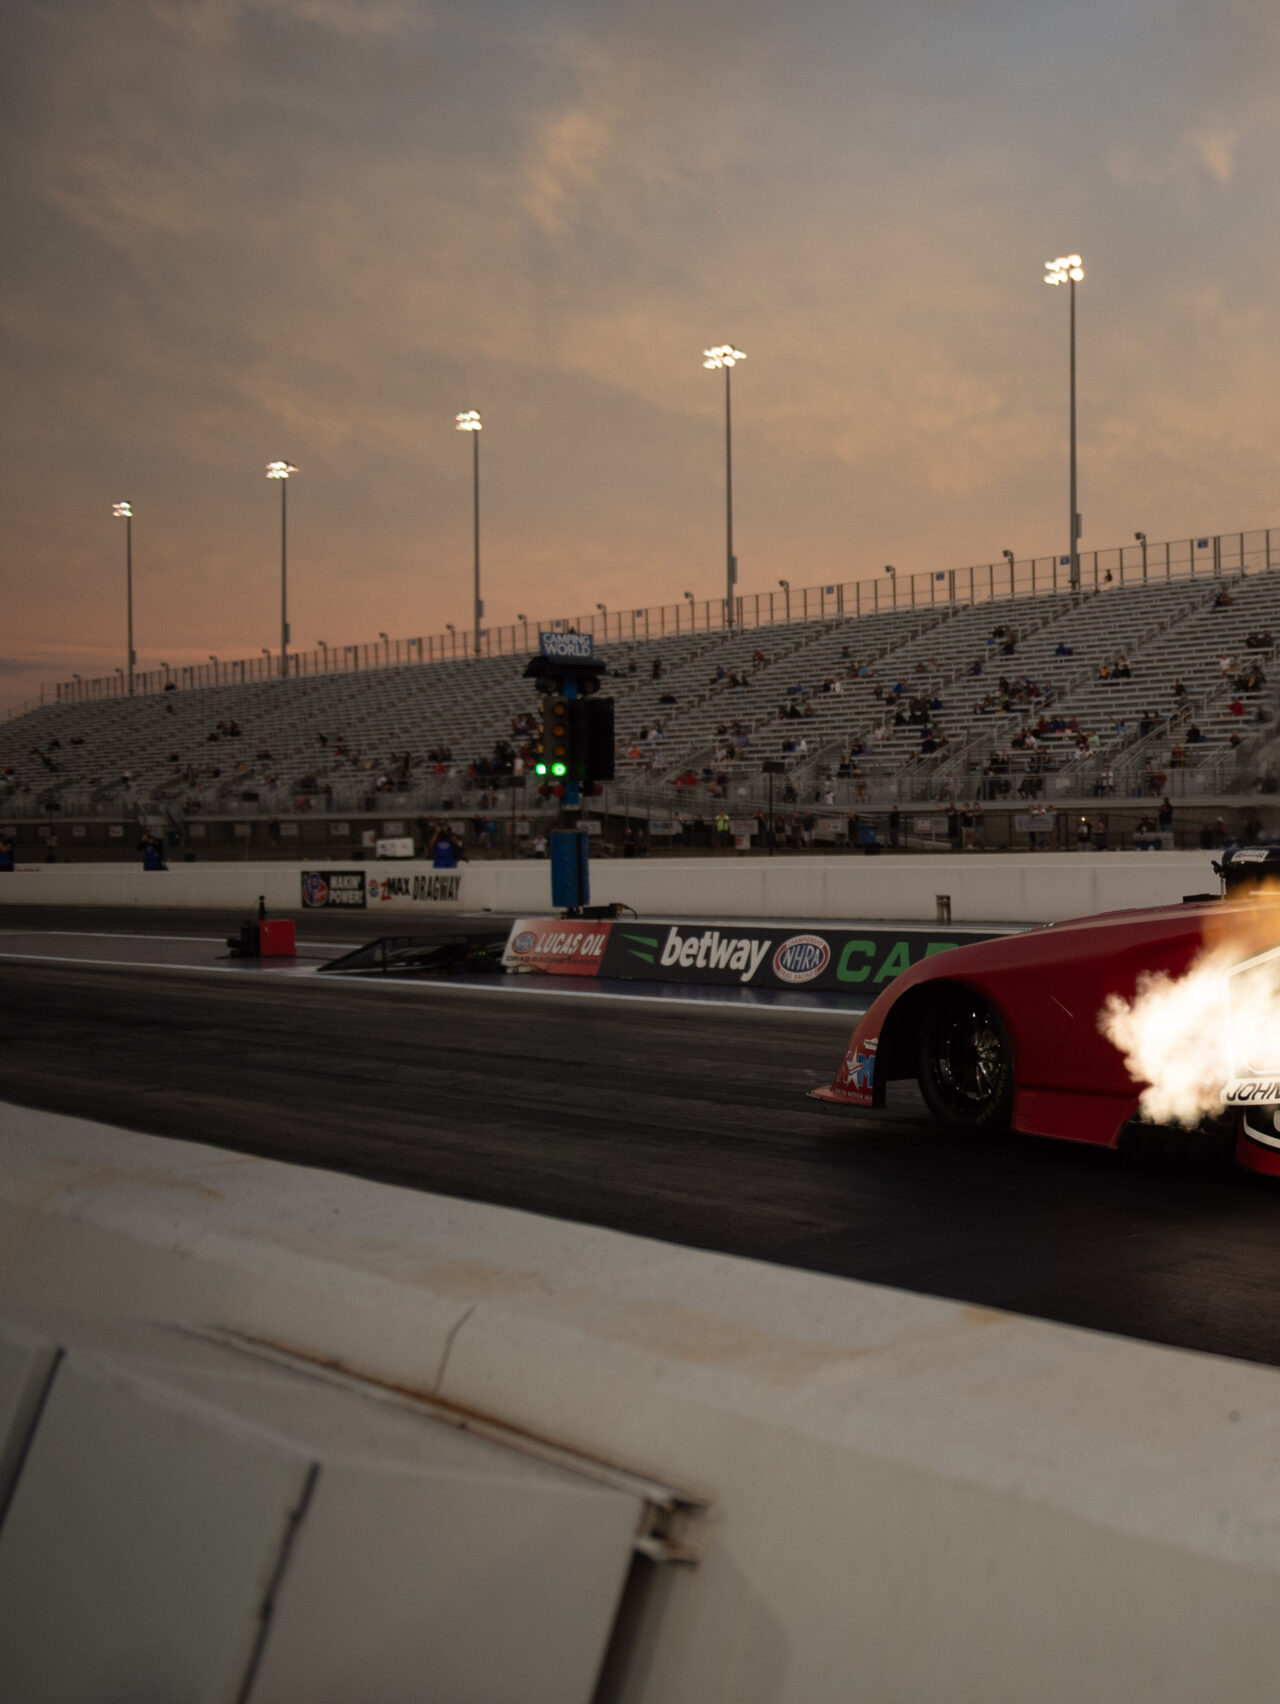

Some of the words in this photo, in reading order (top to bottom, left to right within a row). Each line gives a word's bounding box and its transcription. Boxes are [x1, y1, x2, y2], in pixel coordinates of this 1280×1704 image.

[543, 633, 591, 646] CAMPING
[544, 644, 591, 656] WORLD
[413, 876, 462, 901] DRAGWAY
[534, 933, 584, 955] LUCAS
[580, 934, 607, 956] OIL
[659, 926, 773, 983] betway
[782, 944, 820, 971] NHRA
[836, 940, 962, 984] CA
